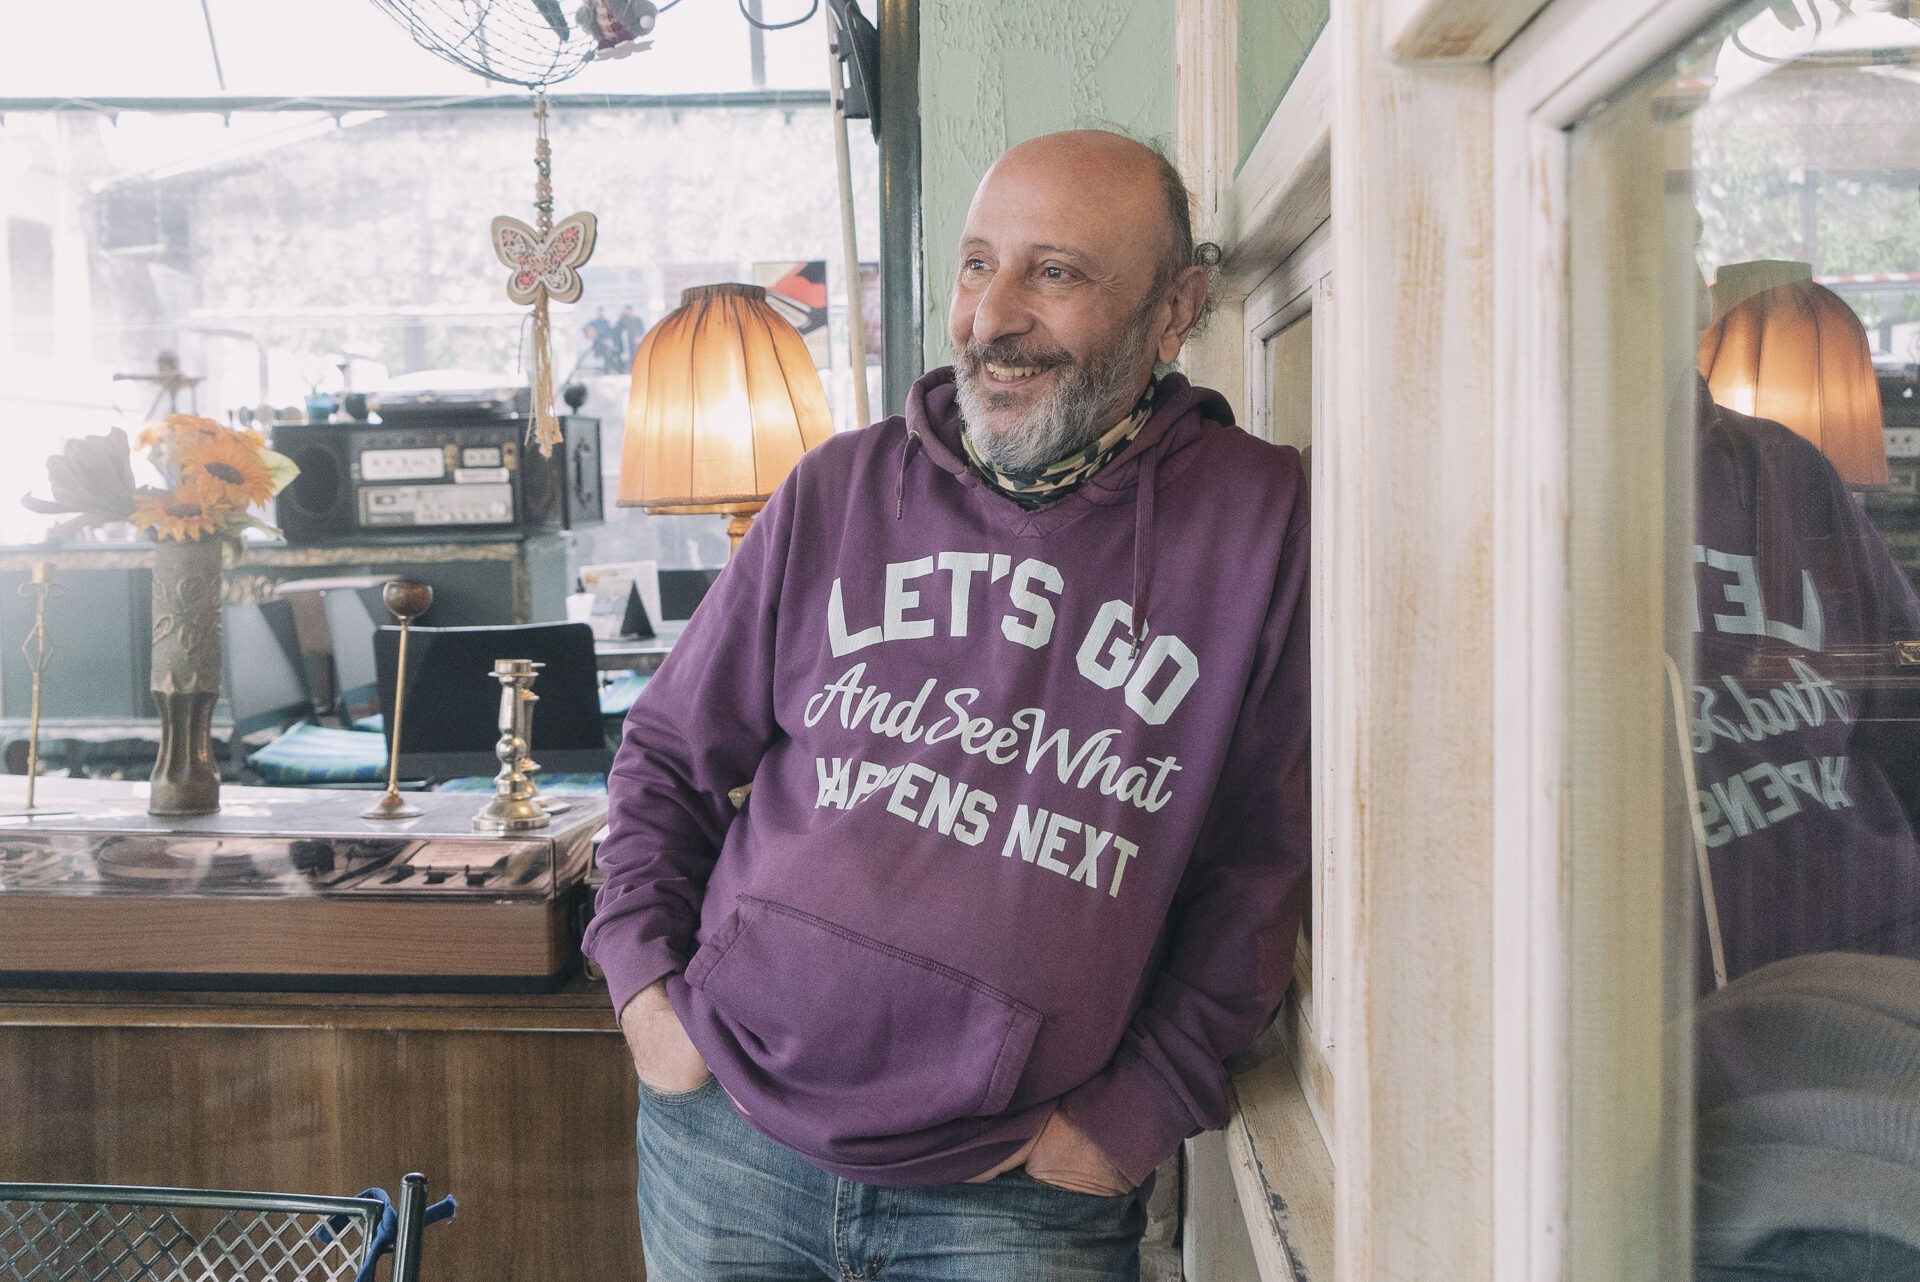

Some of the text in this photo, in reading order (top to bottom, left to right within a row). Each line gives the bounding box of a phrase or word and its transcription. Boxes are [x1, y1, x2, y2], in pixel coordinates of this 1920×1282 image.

[827, 551, 1200, 726] LET'S GO
[803, 662, 1182, 812] And See What
[1001, 804, 1139, 898] NEXT
